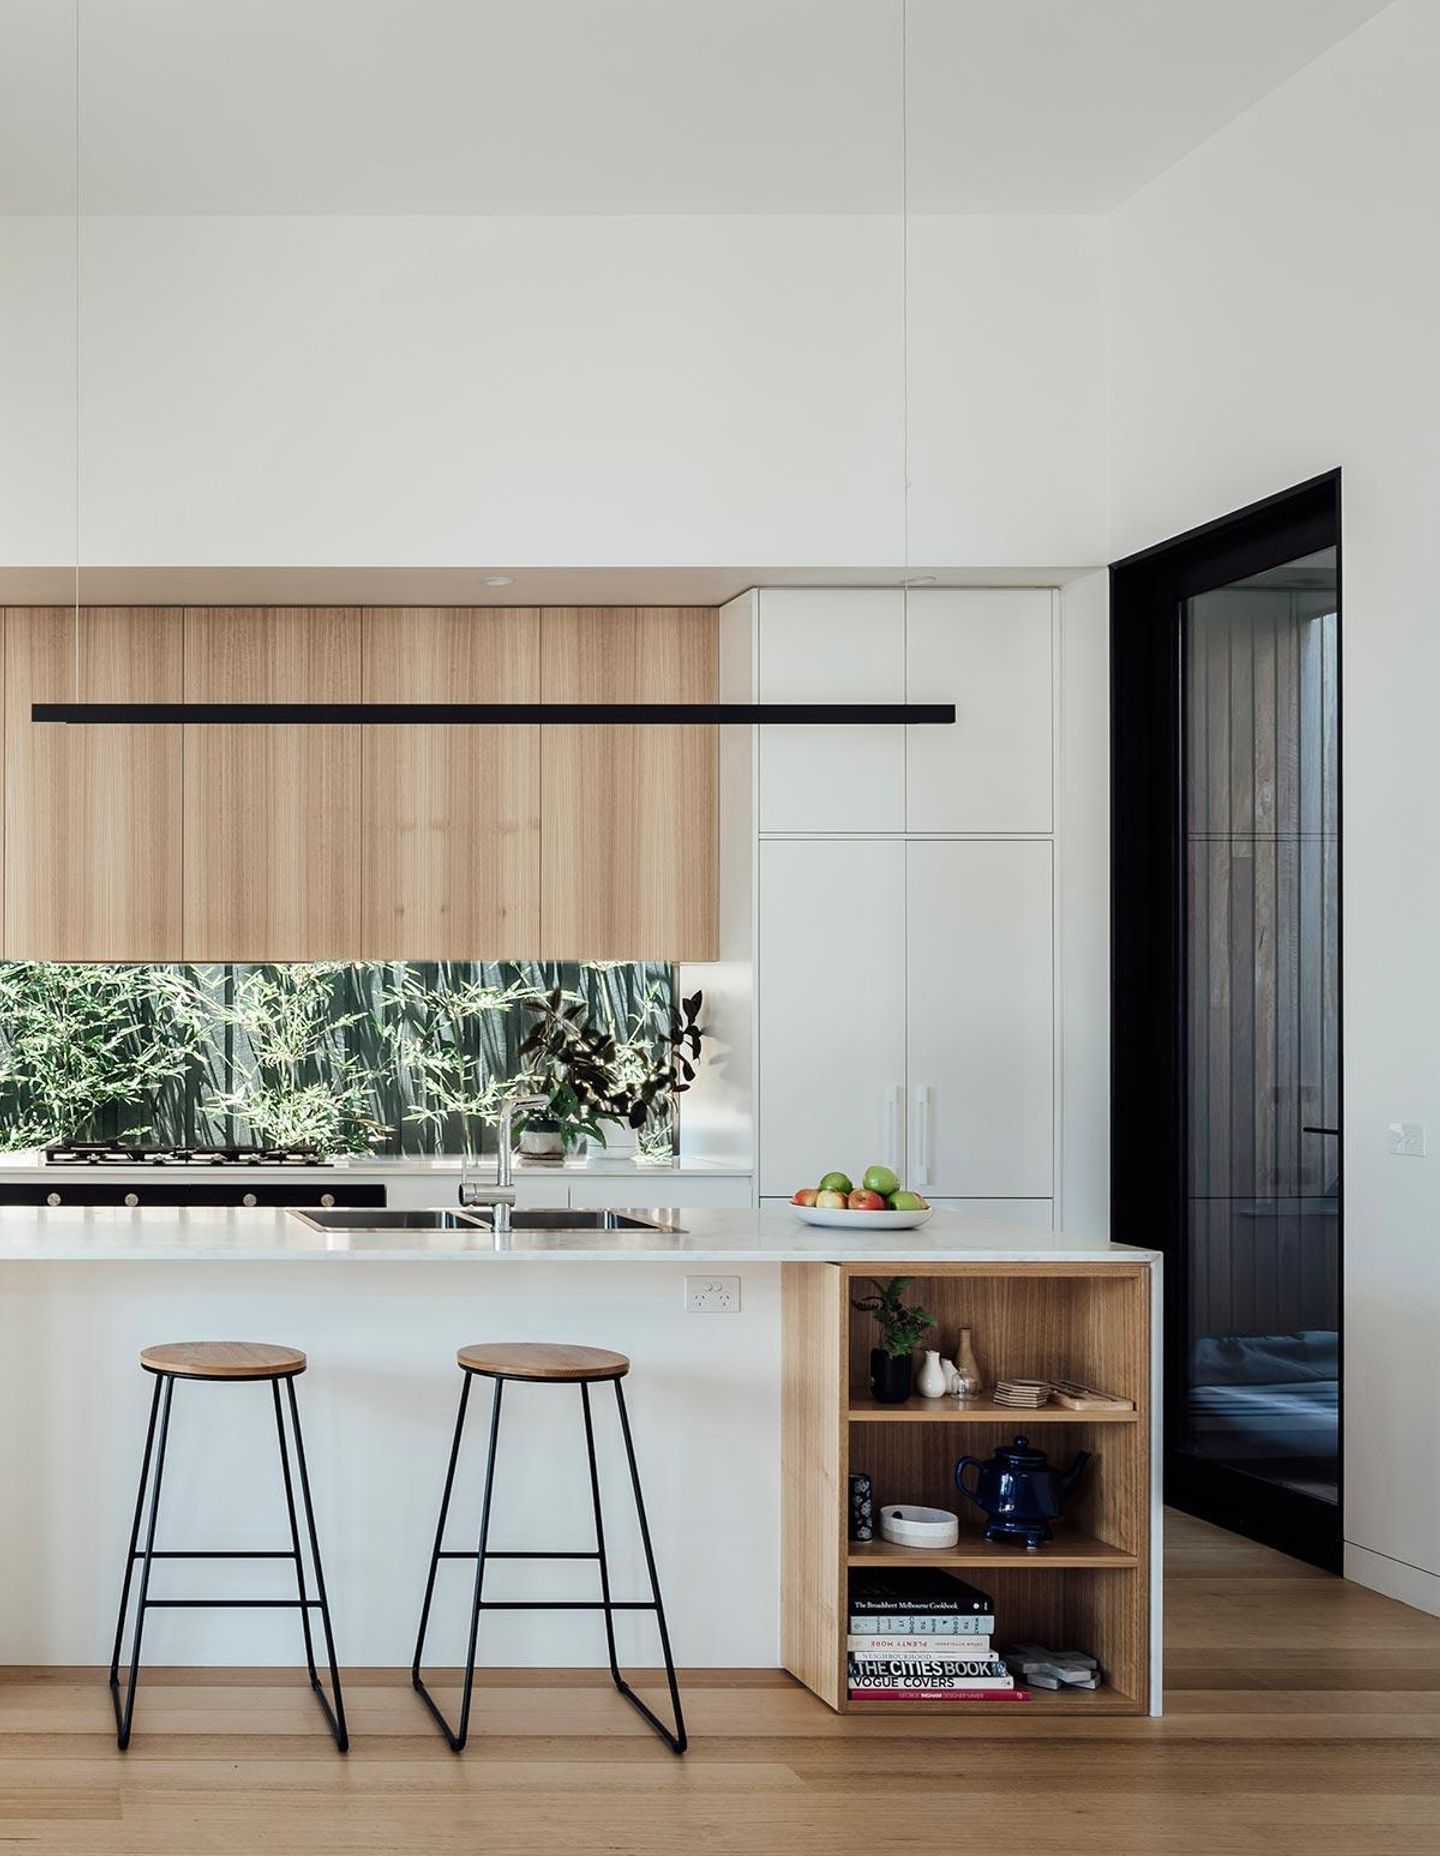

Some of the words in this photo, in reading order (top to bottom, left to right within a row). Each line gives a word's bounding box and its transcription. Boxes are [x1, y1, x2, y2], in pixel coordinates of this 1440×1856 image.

[929, 1602, 958, 1610] Cookbook
[858, 1662, 888, 1675] THE
[889, 1662, 943, 1676] CITIES
[944, 1662, 992, 1676] BOOK
[854, 1677, 899, 1688] VOGUE
[903, 1677, 955, 1688] COVERS
